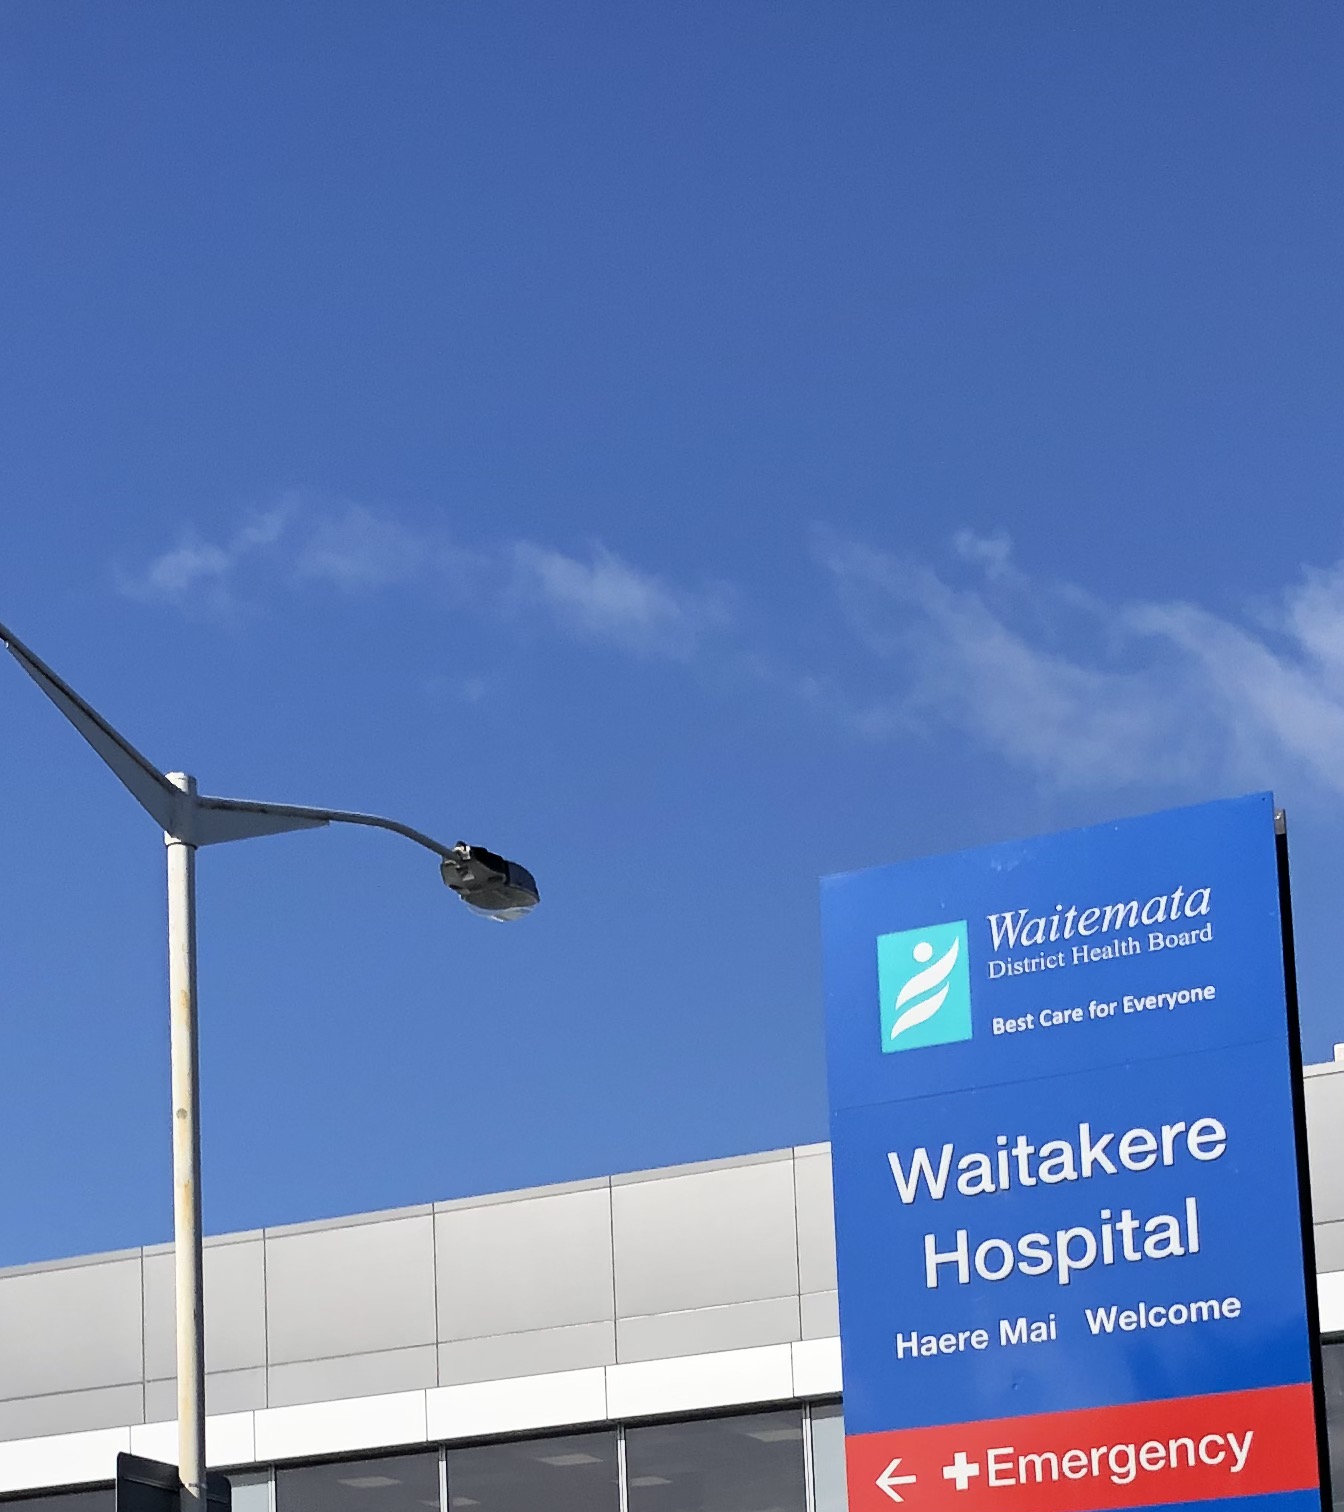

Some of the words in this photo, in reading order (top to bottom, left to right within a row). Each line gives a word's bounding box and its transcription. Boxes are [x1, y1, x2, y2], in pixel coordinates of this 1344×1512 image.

[986, 885, 1211, 952] Waitemata
[988, 951, 1065, 979] District
[1071, 936, 1141, 964] Health
[1148, 922, 1213, 951] Board
[992, 1013, 1035, 1036] Best
[1039, 1007, 1084, 1027] Care
[1088, 1000, 1118, 1020] for
[1122, 984, 1216, 1011] Everyone
[887, 1117, 1227, 1204] Waitakere
[924, 1196, 1200, 1289] Hospital
[895, 1328, 989, 1360] Haere
[999, 1313, 1057, 1346] Mai
[1085, 1296, 1242, 1335] Welcome
[986, 1430, 1255, 1486] Emergency
